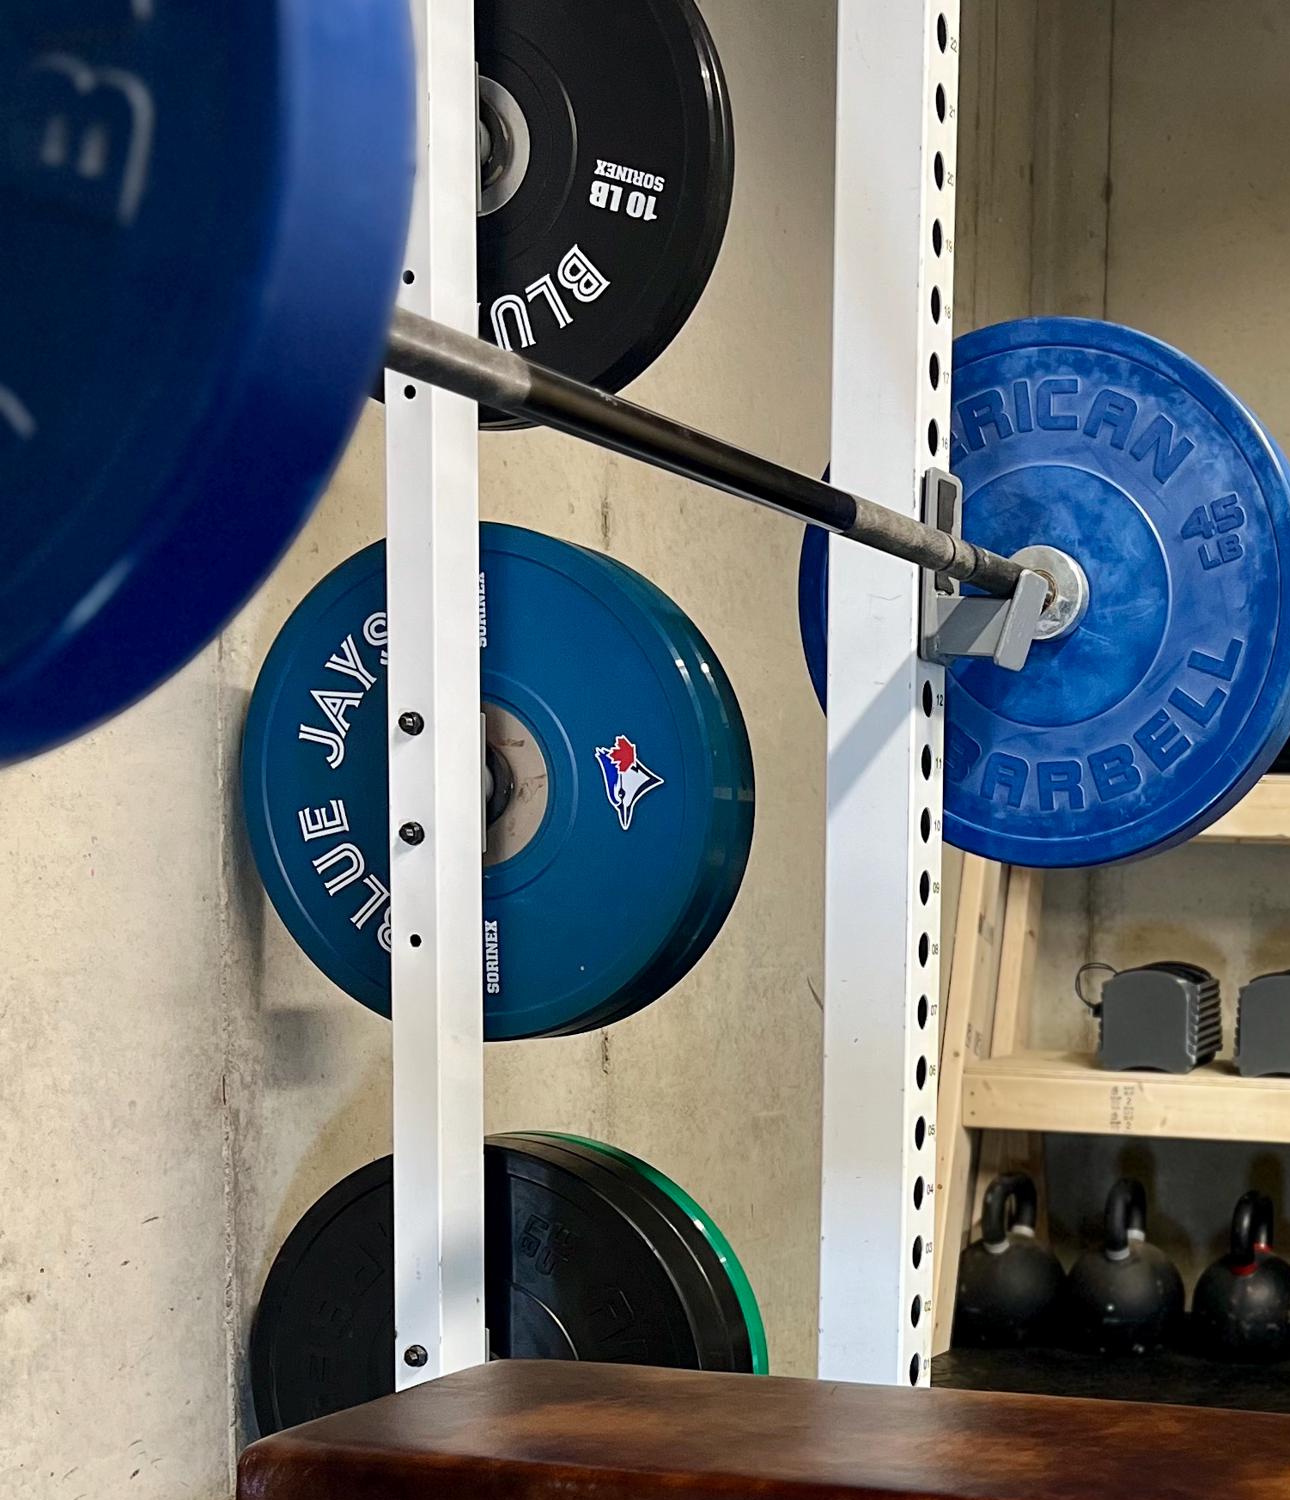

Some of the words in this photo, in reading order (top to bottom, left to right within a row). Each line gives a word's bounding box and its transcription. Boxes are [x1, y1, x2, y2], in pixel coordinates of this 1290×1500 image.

[594, 159, 665, 192] SORINEX
[589, 180, 623, 212] LB
[626, 191, 658, 221] 10
[477, 243, 611, 351] BLU
[943, 371, 950, 384] 17
[941, 436, 948, 450] 16
[1180, 491, 1246, 541] 45
[1197, 532, 1246, 570] LB
[936, 694, 944, 707] 12
[944, 637, 1246, 811] BARBELL
[935, 757, 942, 769] 11
[933, 820, 941, 832] 10
[932, 881, 940, 893] 09
[484, 919, 500, 994] SORINEX
